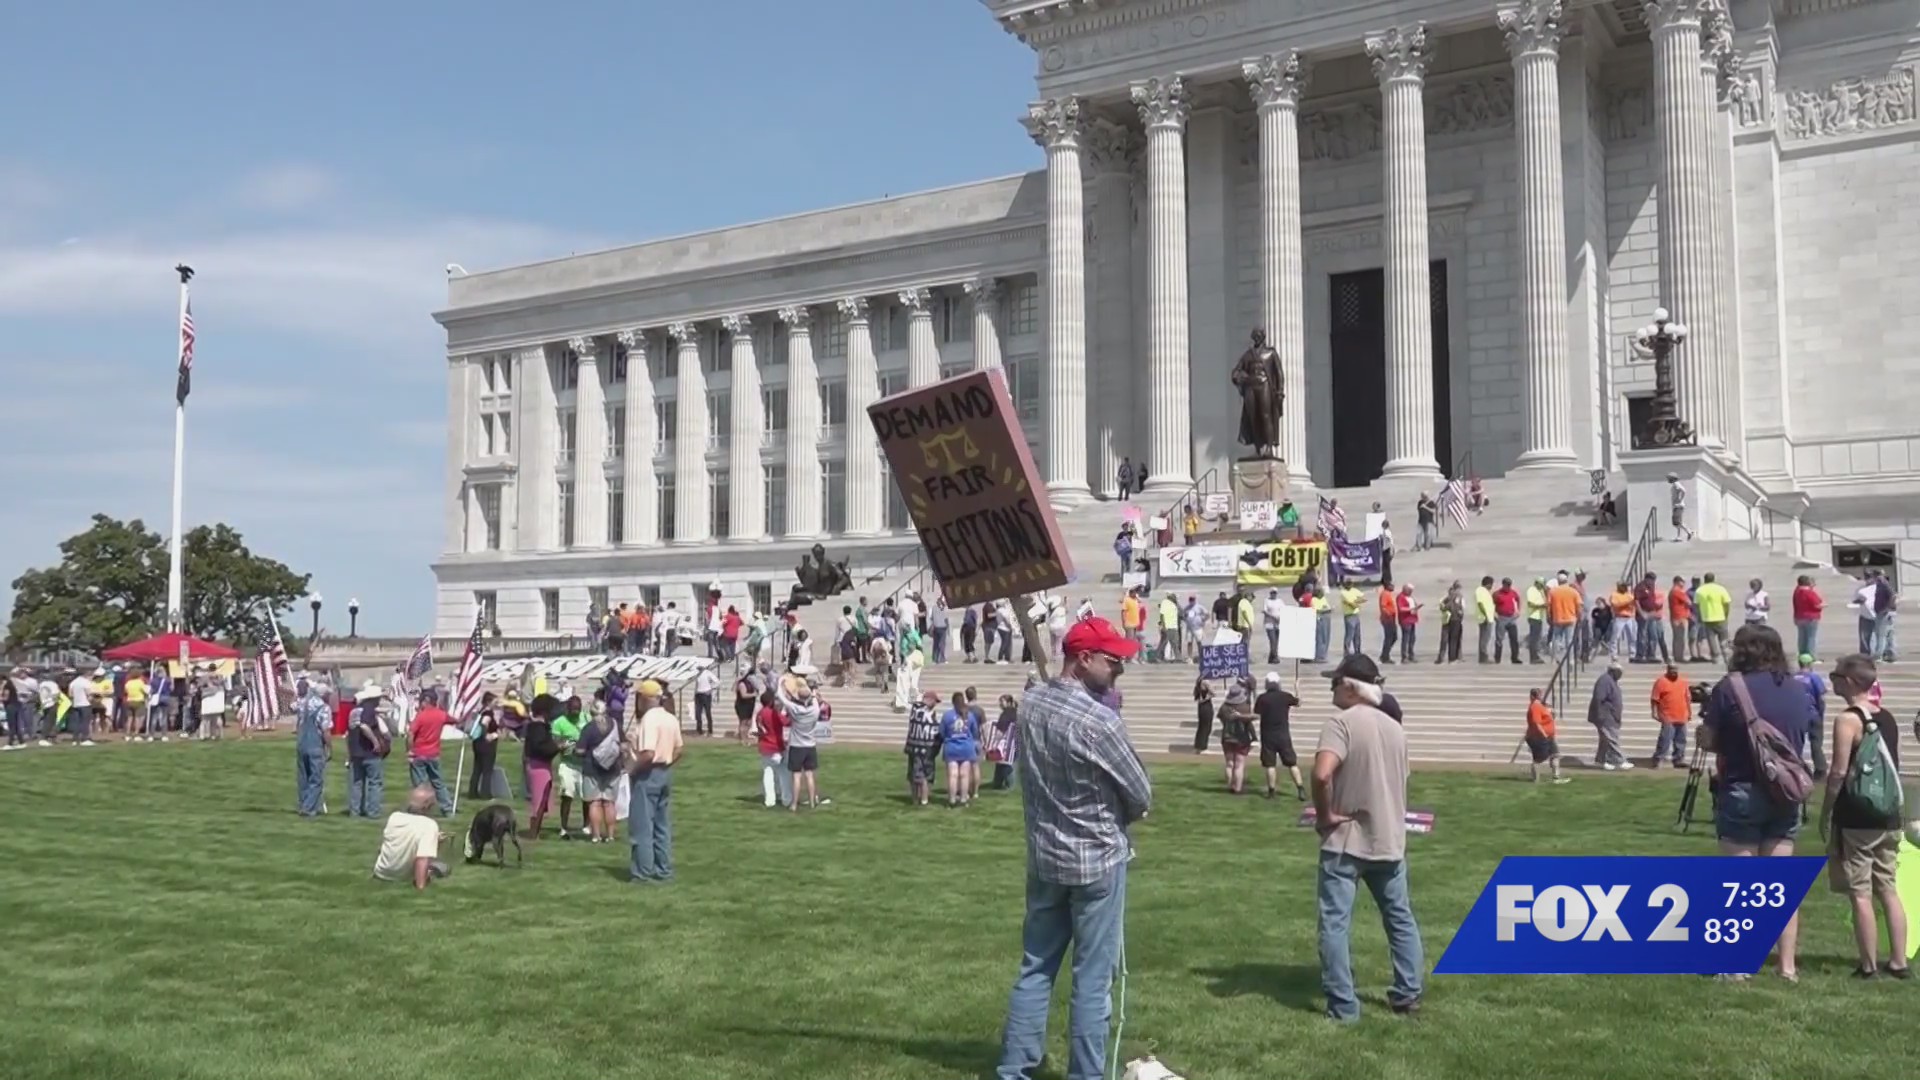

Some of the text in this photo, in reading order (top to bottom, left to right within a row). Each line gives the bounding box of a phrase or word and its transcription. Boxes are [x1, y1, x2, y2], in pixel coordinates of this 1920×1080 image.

[874, 385, 994, 441] DEMAND
[923, 465, 995, 500] FAIR
[921, 499, 1054, 581] ELECTIONS
[1271, 547, 1320, 568] CBTU
[1203, 644, 1246, 658] WE SEE
